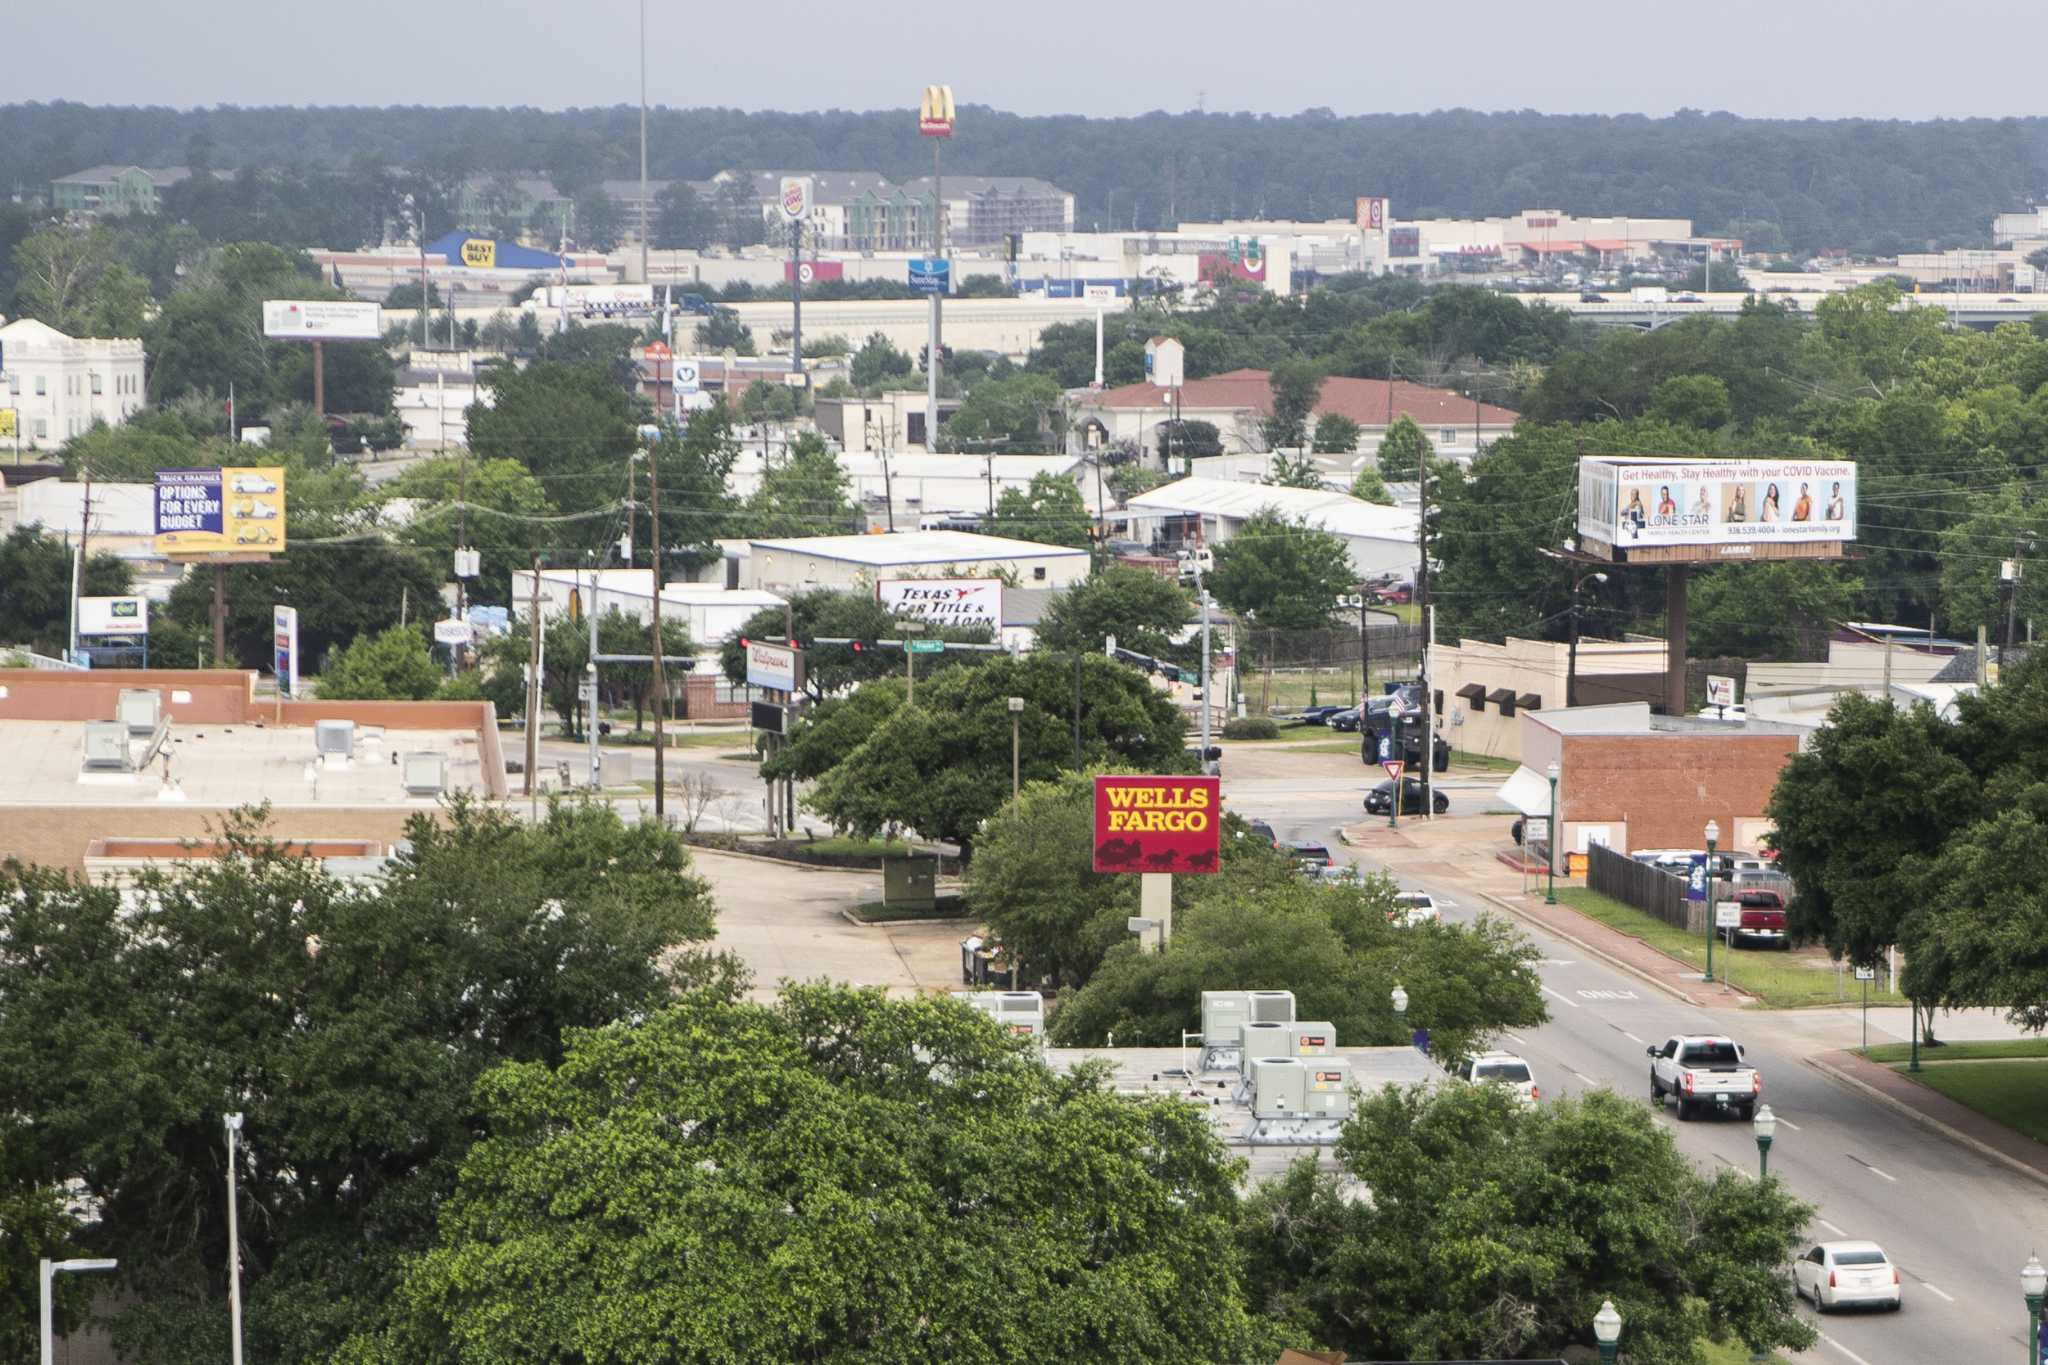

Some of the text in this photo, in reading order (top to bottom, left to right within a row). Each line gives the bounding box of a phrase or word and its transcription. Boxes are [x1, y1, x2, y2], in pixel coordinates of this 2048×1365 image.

[466, 243, 492, 252] BEST
[467, 254, 489, 262] BUY
[1622, 470, 1639, 480] Get
[1641, 469, 1678, 481] Healthy,
[1681, 467, 1701, 479] Stay
[1702, 467, 1737, 479] Healthy
[1740, 467, 1759, 477] with
[1762, 469, 1780, 479] your
[1783, 465, 1812, 476] COVID
[1815, 465, 1850, 476] Vaccine.
[160, 486, 208, 500] OPTIONS
[160, 499, 219, 514] FOR EVERY
[160, 514, 202, 529] BUDGET
[1648, 513, 1709, 526] LONE STAR
[1720, 545, 1751, 554] LAMAR
[903, 588, 952, 600] TEXAS
[932, 601, 973, 613] TITLE
[752, 646, 789, 670] Walgreens
[1105, 787, 1209, 809] WELLS
[1108, 811, 1208, 832] FARGO
[1576, 989, 1640, 1000] ONLY
